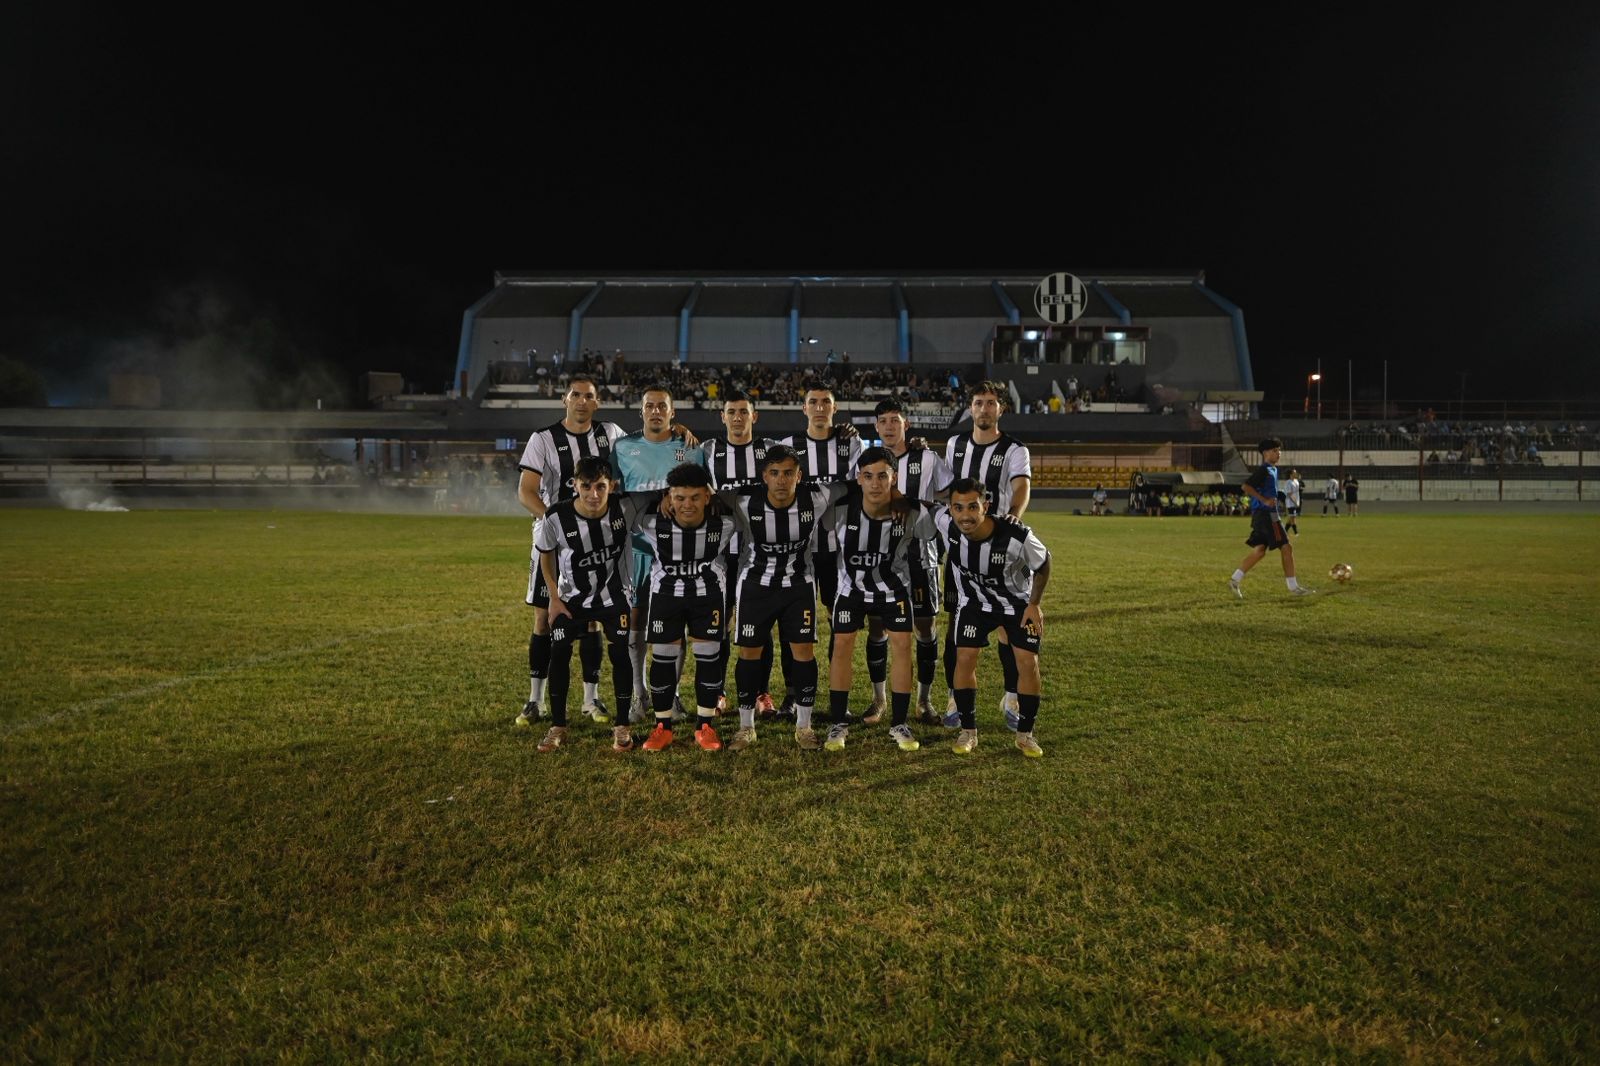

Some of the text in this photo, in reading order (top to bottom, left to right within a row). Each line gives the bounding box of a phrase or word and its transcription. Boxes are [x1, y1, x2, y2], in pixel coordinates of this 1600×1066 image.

[1043, 295, 1079, 304] BELL
[620, 614, 628, 628] 8
[711, 609, 720, 626] 3
[803, 609, 811, 626] 5
